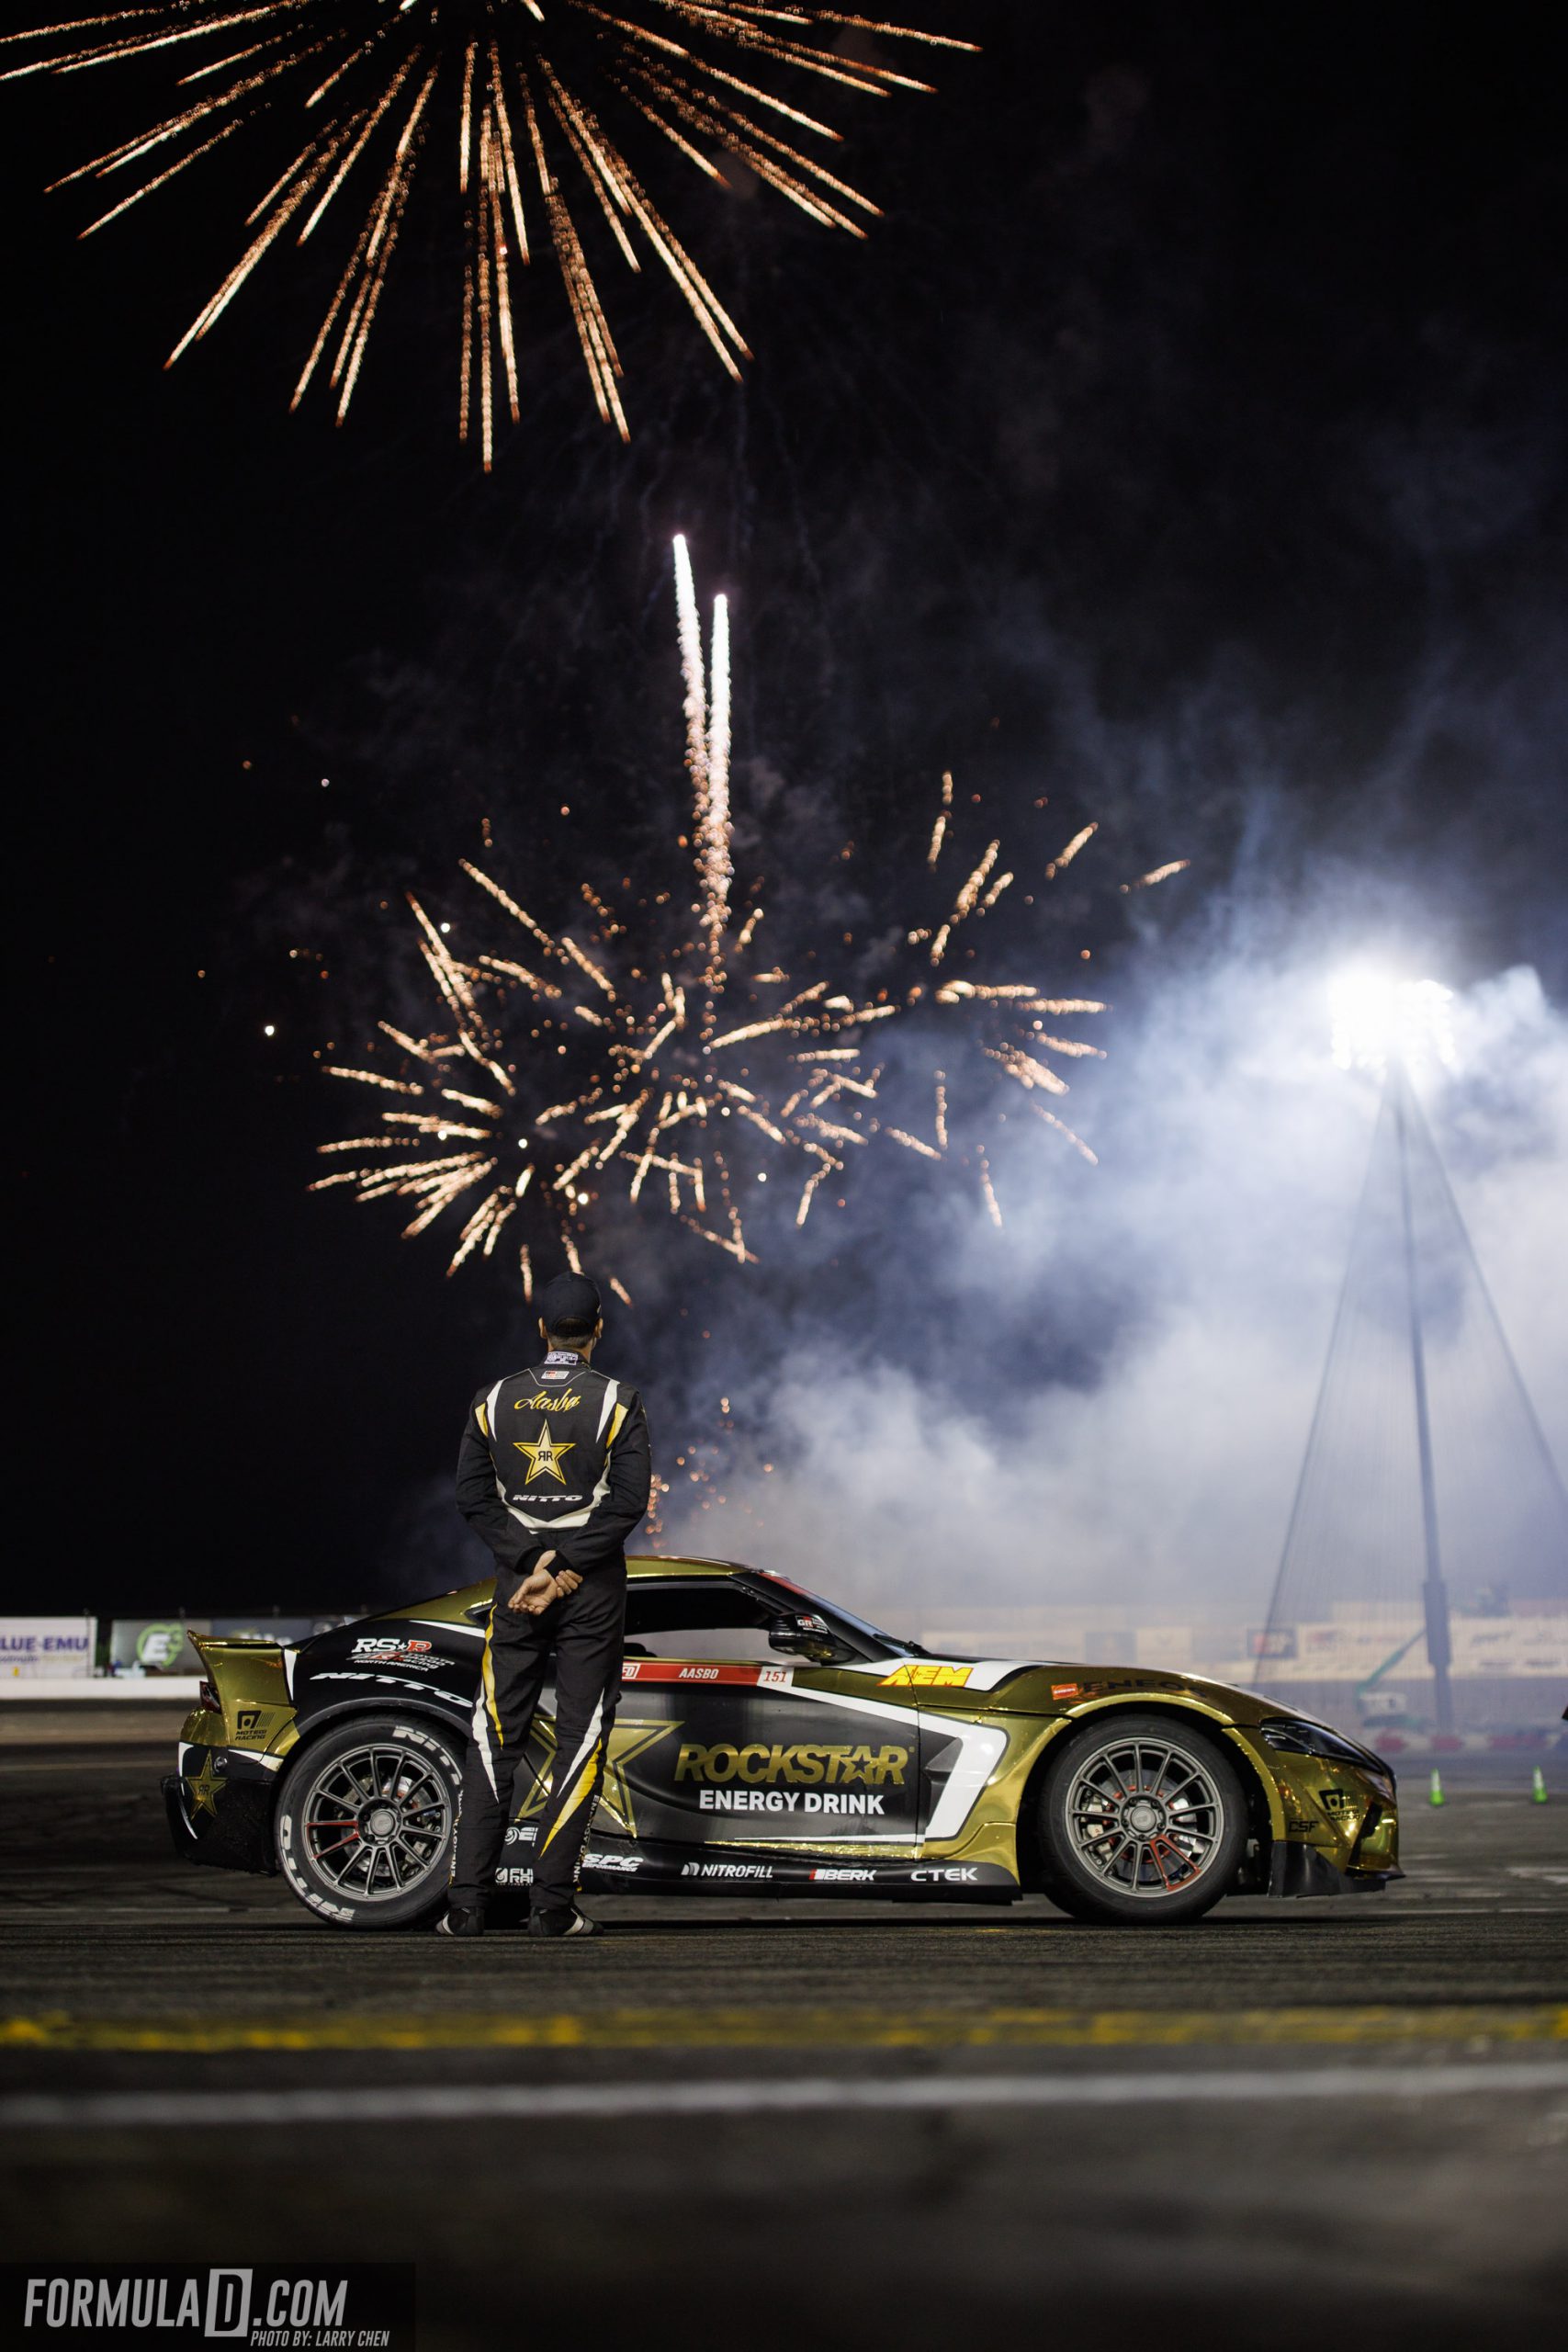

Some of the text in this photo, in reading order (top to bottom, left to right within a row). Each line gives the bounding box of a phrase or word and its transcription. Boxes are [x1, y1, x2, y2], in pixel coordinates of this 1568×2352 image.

[513, 1494, 583, 1502] NITTO
[0, 1635, 88, 1651] LUE-EMU
[678, 1668, 720, 1680] AASBO
[763, 1670, 787, 1683] 151
[878, 1664, 974, 1687] AEM
[310, 1672, 474, 1708] NITTO
[392, 1724, 463, 1786] NITT
[674, 1743, 908, 1785] ROCKSTAR
[699, 1790, 886, 1815] ENERGY DRINK
[1289, 1821, 1318, 1833] CSF
[700, 1864, 773, 1879] NITROFILL
[824, 1868, 877, 1881] BERK
[910, 1867, 977, 1882] CTEK
